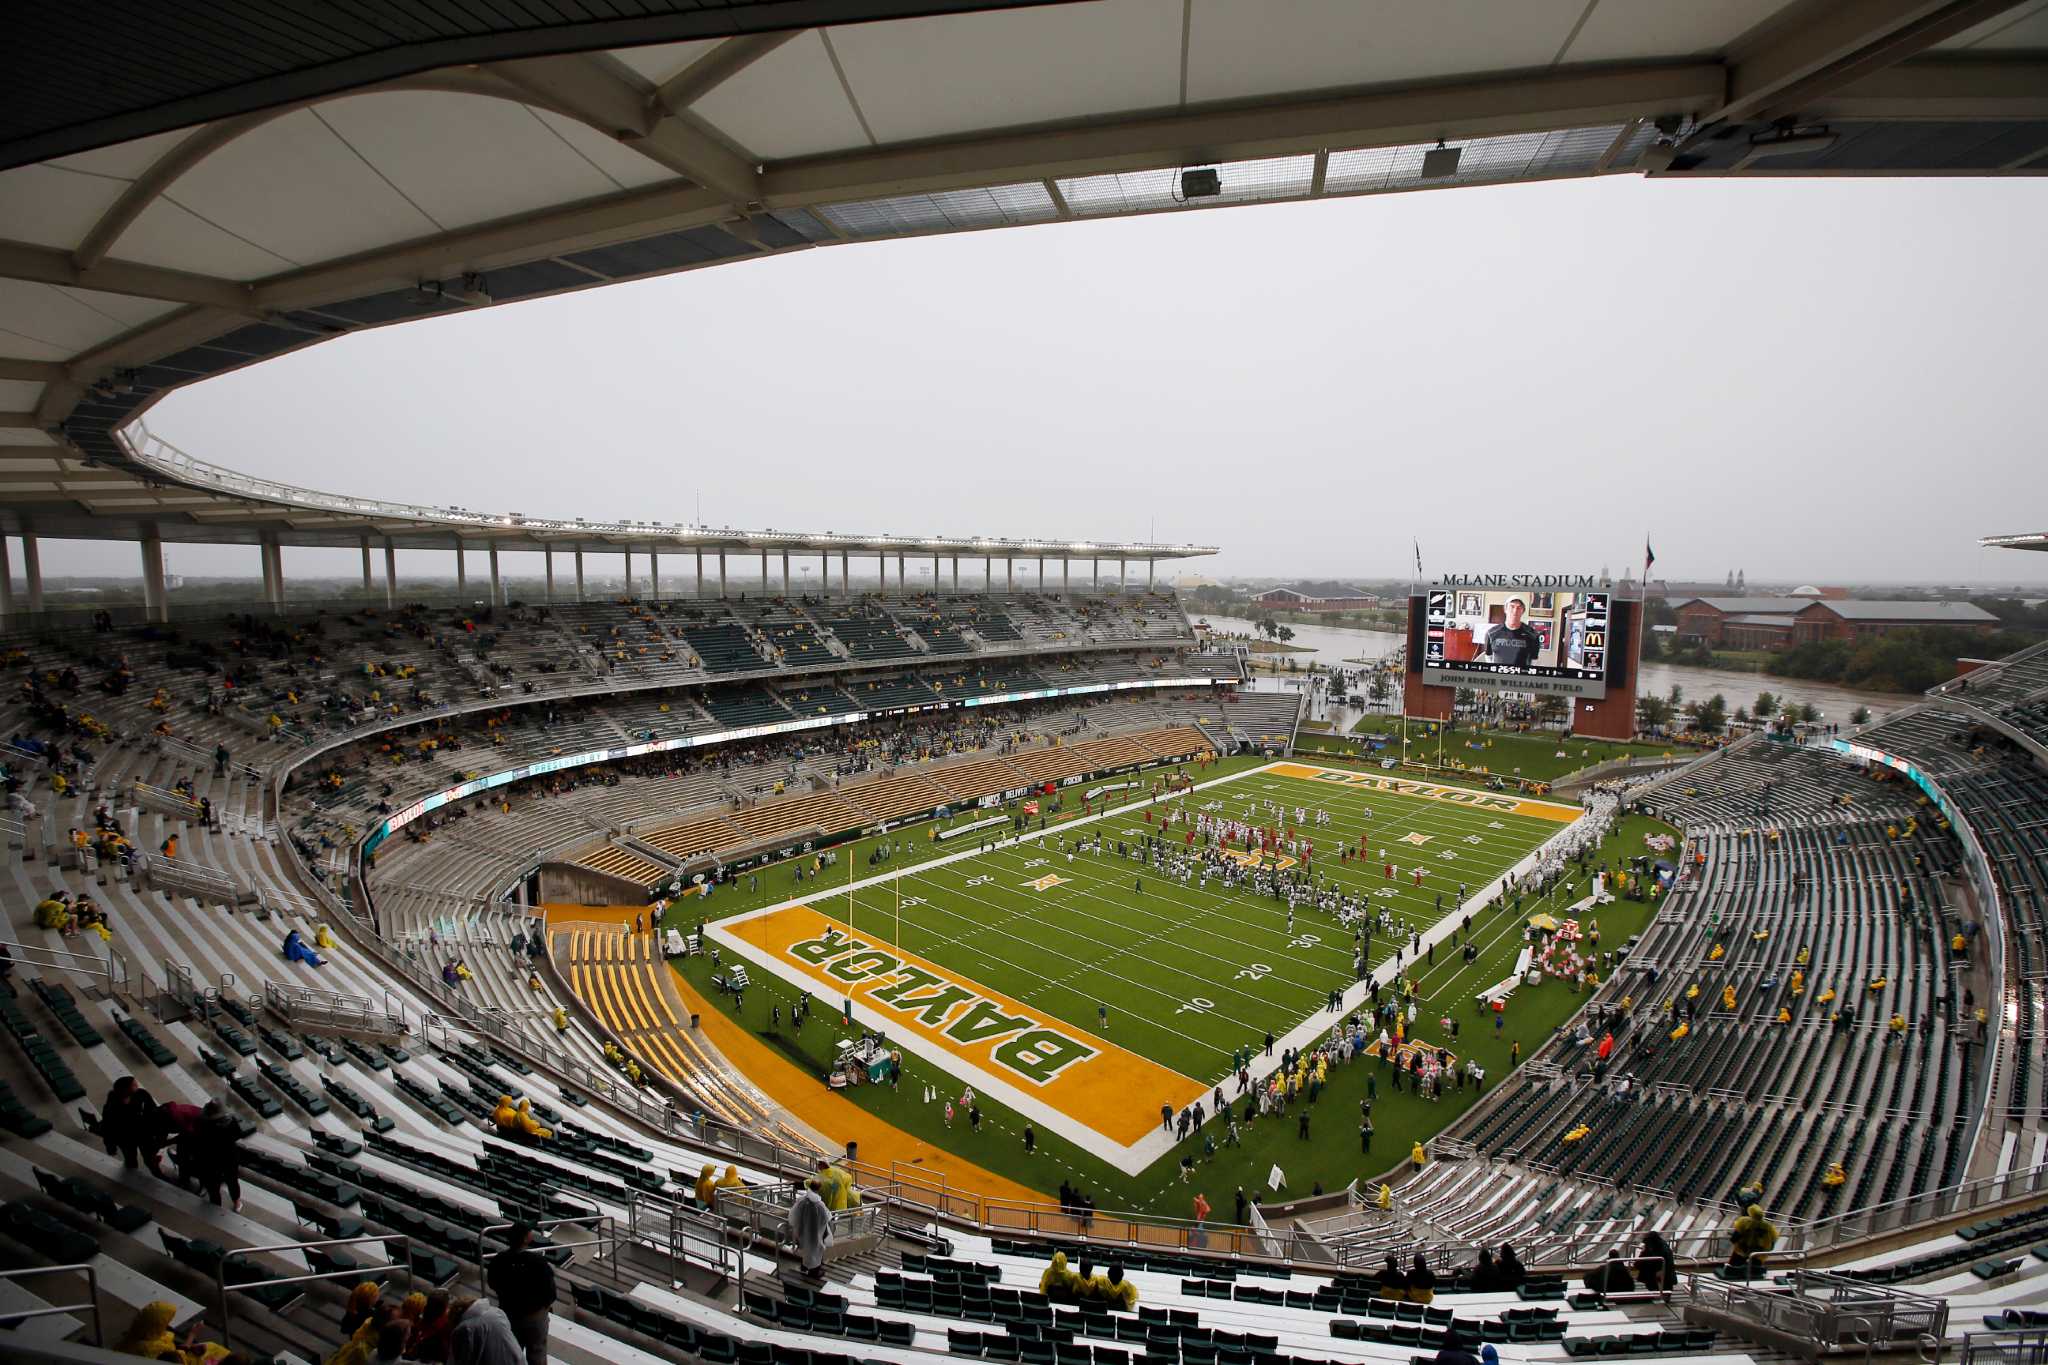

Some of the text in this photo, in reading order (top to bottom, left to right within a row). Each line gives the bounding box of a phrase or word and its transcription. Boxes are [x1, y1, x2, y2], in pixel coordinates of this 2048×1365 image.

[1443, 573, 1595, 588] McLANE STADIUM
[1497, 665, 1521, 674] 26:54
[1440, 675, 1584, 693] JOHN EDDIE WILLIAMS FIELD
[1585, 704, 1595, 712] 25
[534, 752, 601, 774] PRESENTED BY
[1062, 775, 1083, 787] #SICEM
[1312, 771, 1521, 813] BAYLOR
[978, 793, 1001, 807] ALWAYS
[389, 802, 425, 832] BAYLOR
[967, 874, 995, 887] 20
[1373, 886, 1400, 898] 50
[902, 896, 928, 907] 10
[1292, 934, 1322, 949] 30
[1240, 962, 1273, 981] 20
[785, 929, 1103, 1088] BAYLOR
[1183, 997, 1216, 1014] 10
